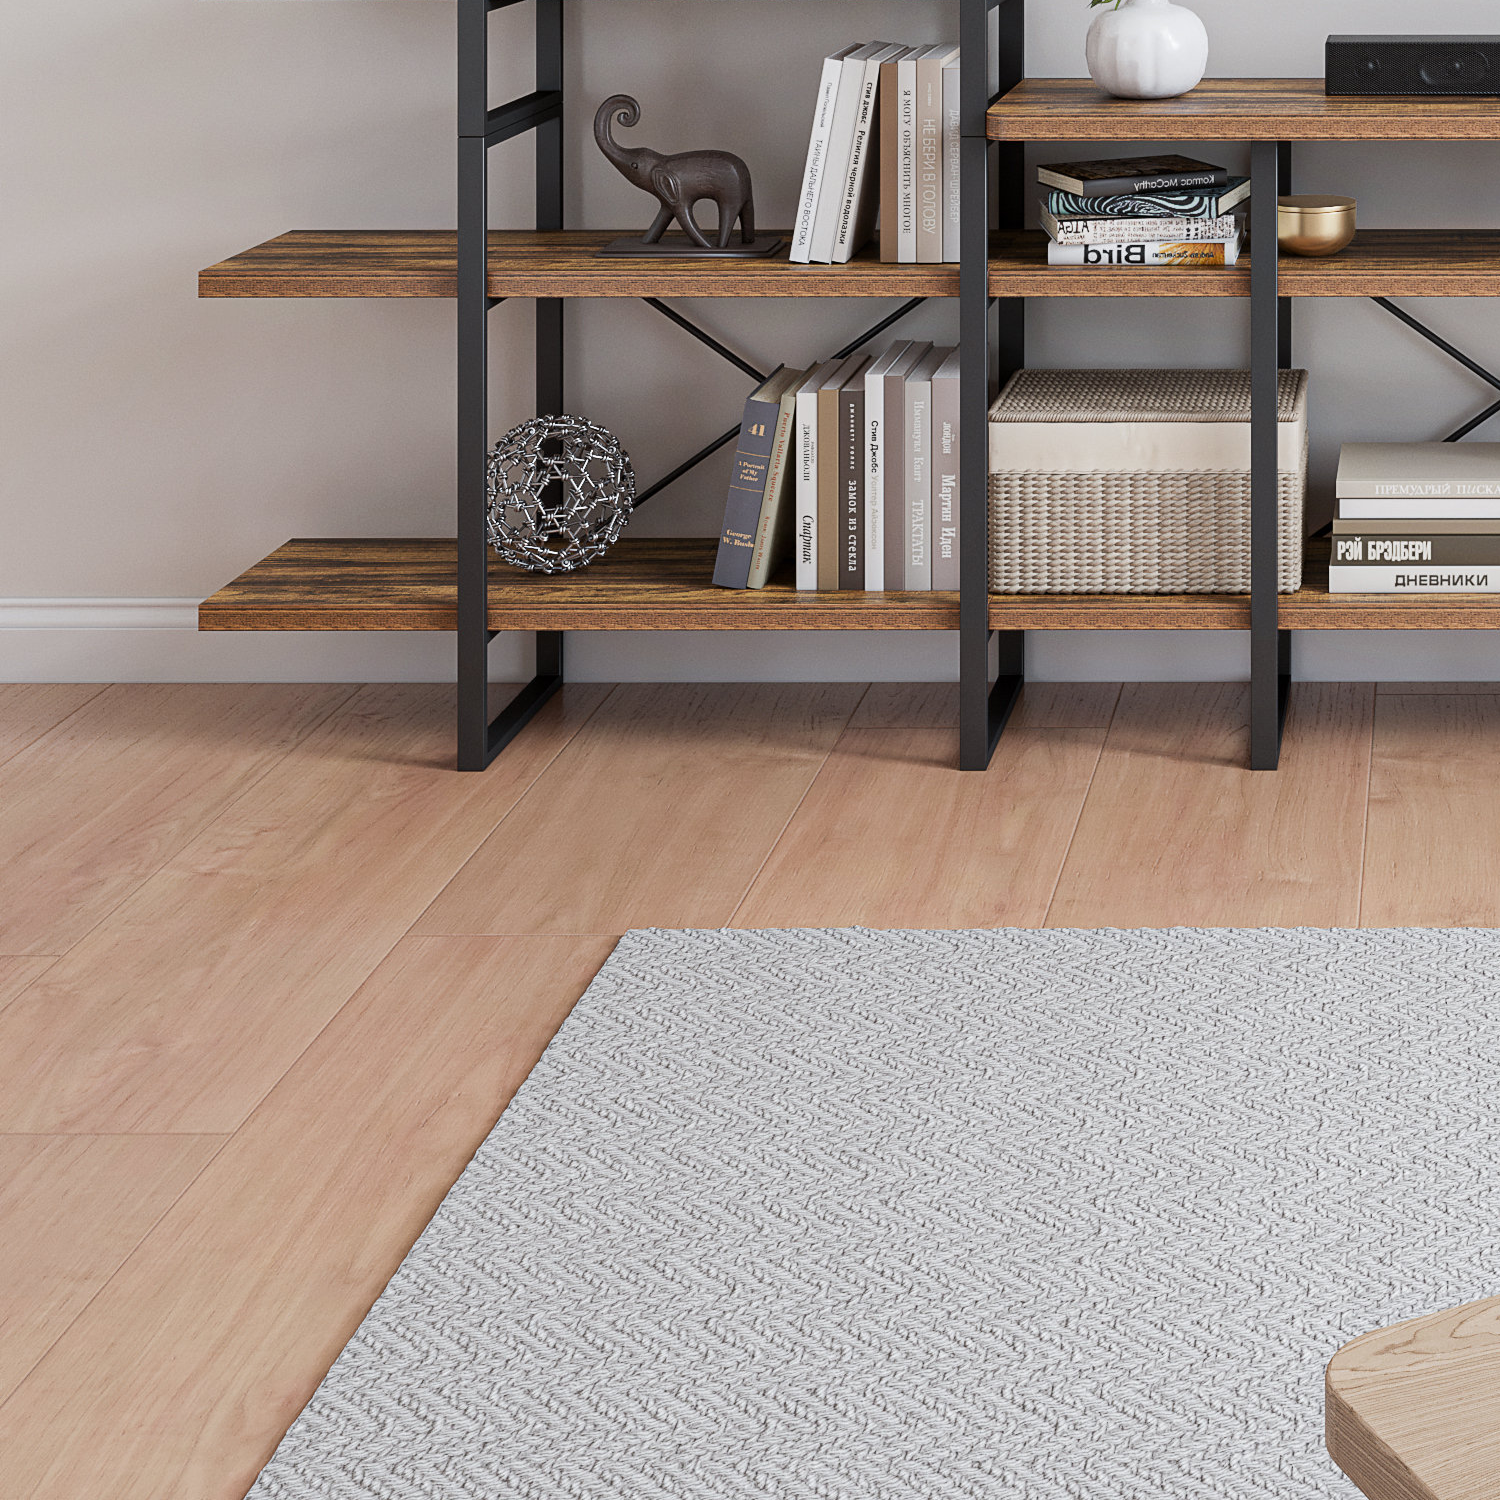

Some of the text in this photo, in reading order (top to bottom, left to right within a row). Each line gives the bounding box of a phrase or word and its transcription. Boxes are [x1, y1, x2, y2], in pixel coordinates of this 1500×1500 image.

[860, 100, 870, 124] джобс
[903, 99, 912, 126] МОГУ
[922, 119, 936, 135] НЕ
[903, 130, 912, 190] ОБЪЯСНИТЬ
[922, 137, 936, 171] БЕРИ
[839, 130, 866, 245] Религия черной водолазки
[922, 173, 936, 182] В
[903, 192, 911, 234] МНОГОЕ
[922, 185, 937, 235] ГОЛОВУ
[798, 209, 811, 246] ВОСТОКА
[748, 423, 765, 437] 41
[871, 420, 879, 442] Стив
[768, 412, 791, 502] Puerto Vallarta Squeeze
[870, 443, 879, 474] Джобс
[1375, 483, 1451, 496] ПРЕМУДРЫЙ
[939, 474, 956, 559] Мартин Иден
[722, 536, 733, 546] W.
[726, 529, 752, 540] George
[799, 515, 815, 564] Спартак
[912, 499, 924, 566] ТРАКТАТЫ
[1337, 537, 1432, 562] РЭЙ БРЭДБЕРИ
[1394, 574, 1489, 588] ДНЕВНИКИ
